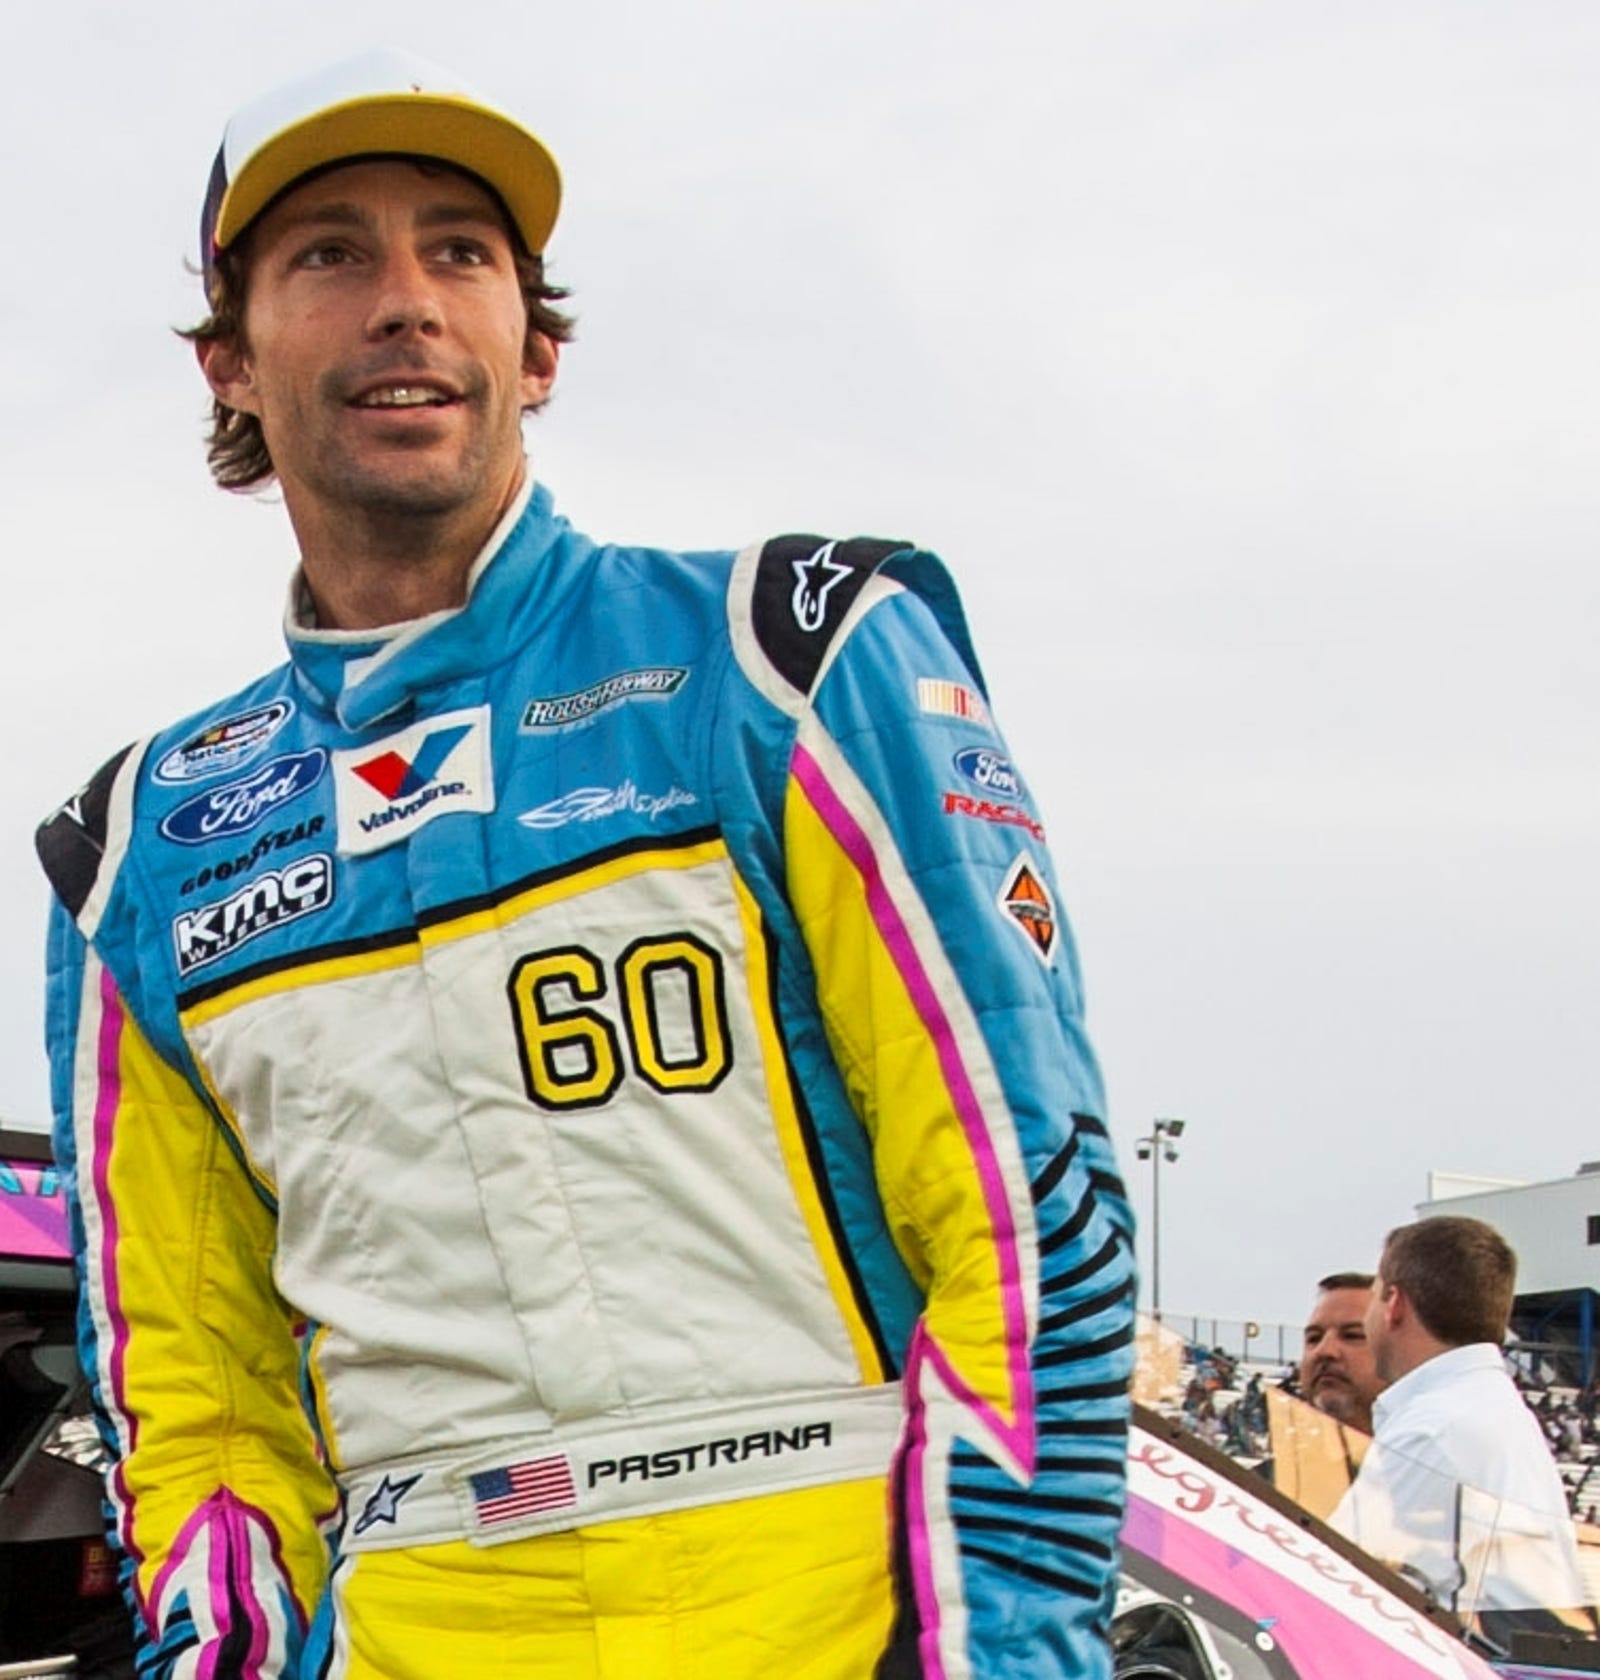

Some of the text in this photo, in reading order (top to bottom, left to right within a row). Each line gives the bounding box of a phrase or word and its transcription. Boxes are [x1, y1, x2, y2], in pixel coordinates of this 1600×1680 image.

[201, 762, 302, 834] Ford
[358, 780, 466, 833] Valvoline
[180, 815, 325, 896] GOODYEAR
[506, 931, 734, 1111] 60
[587, 1421, 832, 1488] PASTRANA
